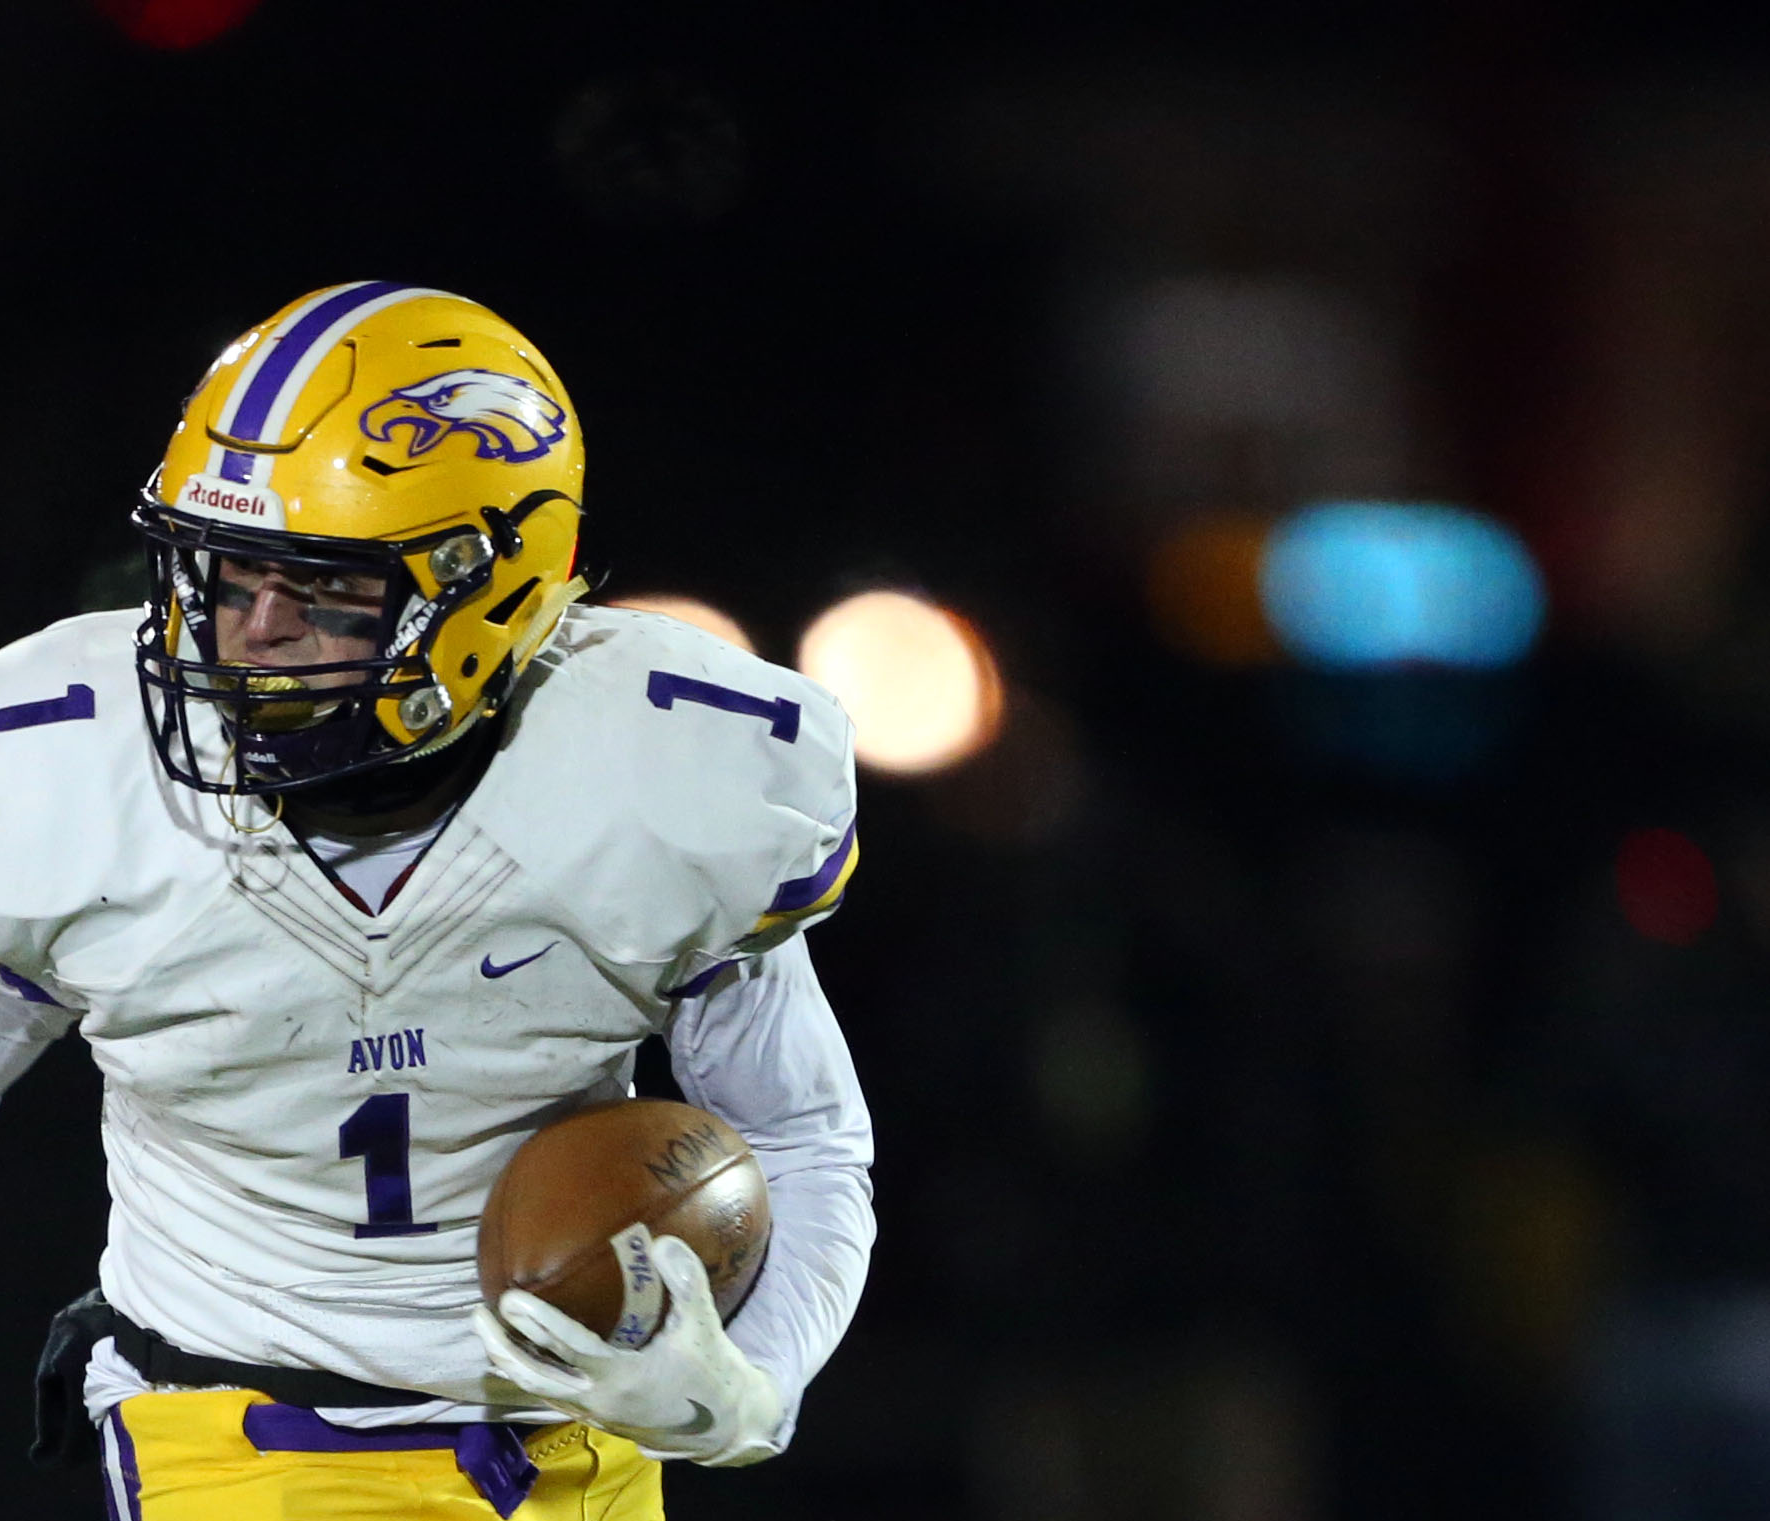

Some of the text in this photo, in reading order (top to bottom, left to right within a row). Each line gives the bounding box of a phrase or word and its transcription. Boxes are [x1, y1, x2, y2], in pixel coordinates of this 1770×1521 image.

[187, 481, 265, 516] Riddell
[646, 669, 802, 744] 1
[347, 1028, 427, 1073] AVON
[338, 1092, 439, 1240] 1
